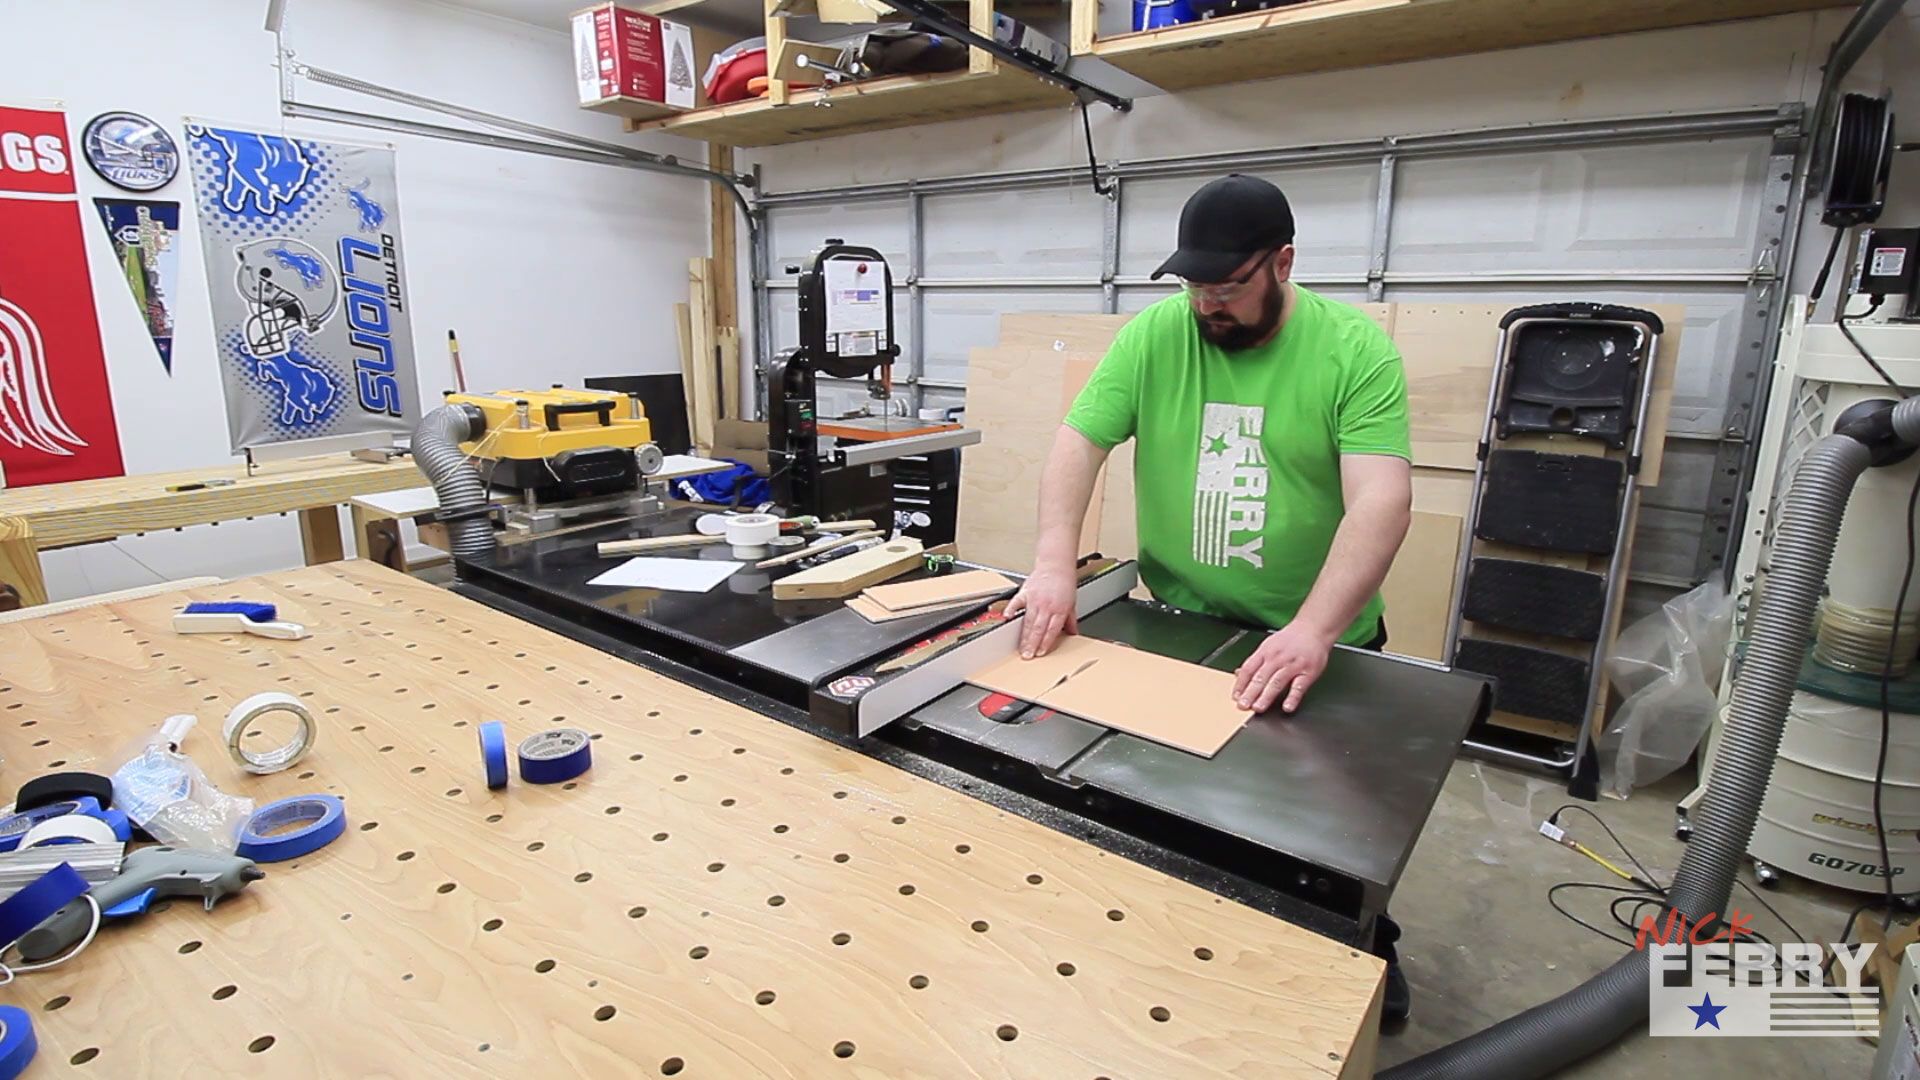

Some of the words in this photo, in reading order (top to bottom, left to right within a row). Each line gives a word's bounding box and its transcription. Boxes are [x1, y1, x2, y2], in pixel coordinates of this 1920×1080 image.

[0, 131, 67, 174] GS
[337, 236, 402, 417] LIONS
[381, 233, 402, 313] DETROIT
[1225, 404, 1268, 569] FERRY
